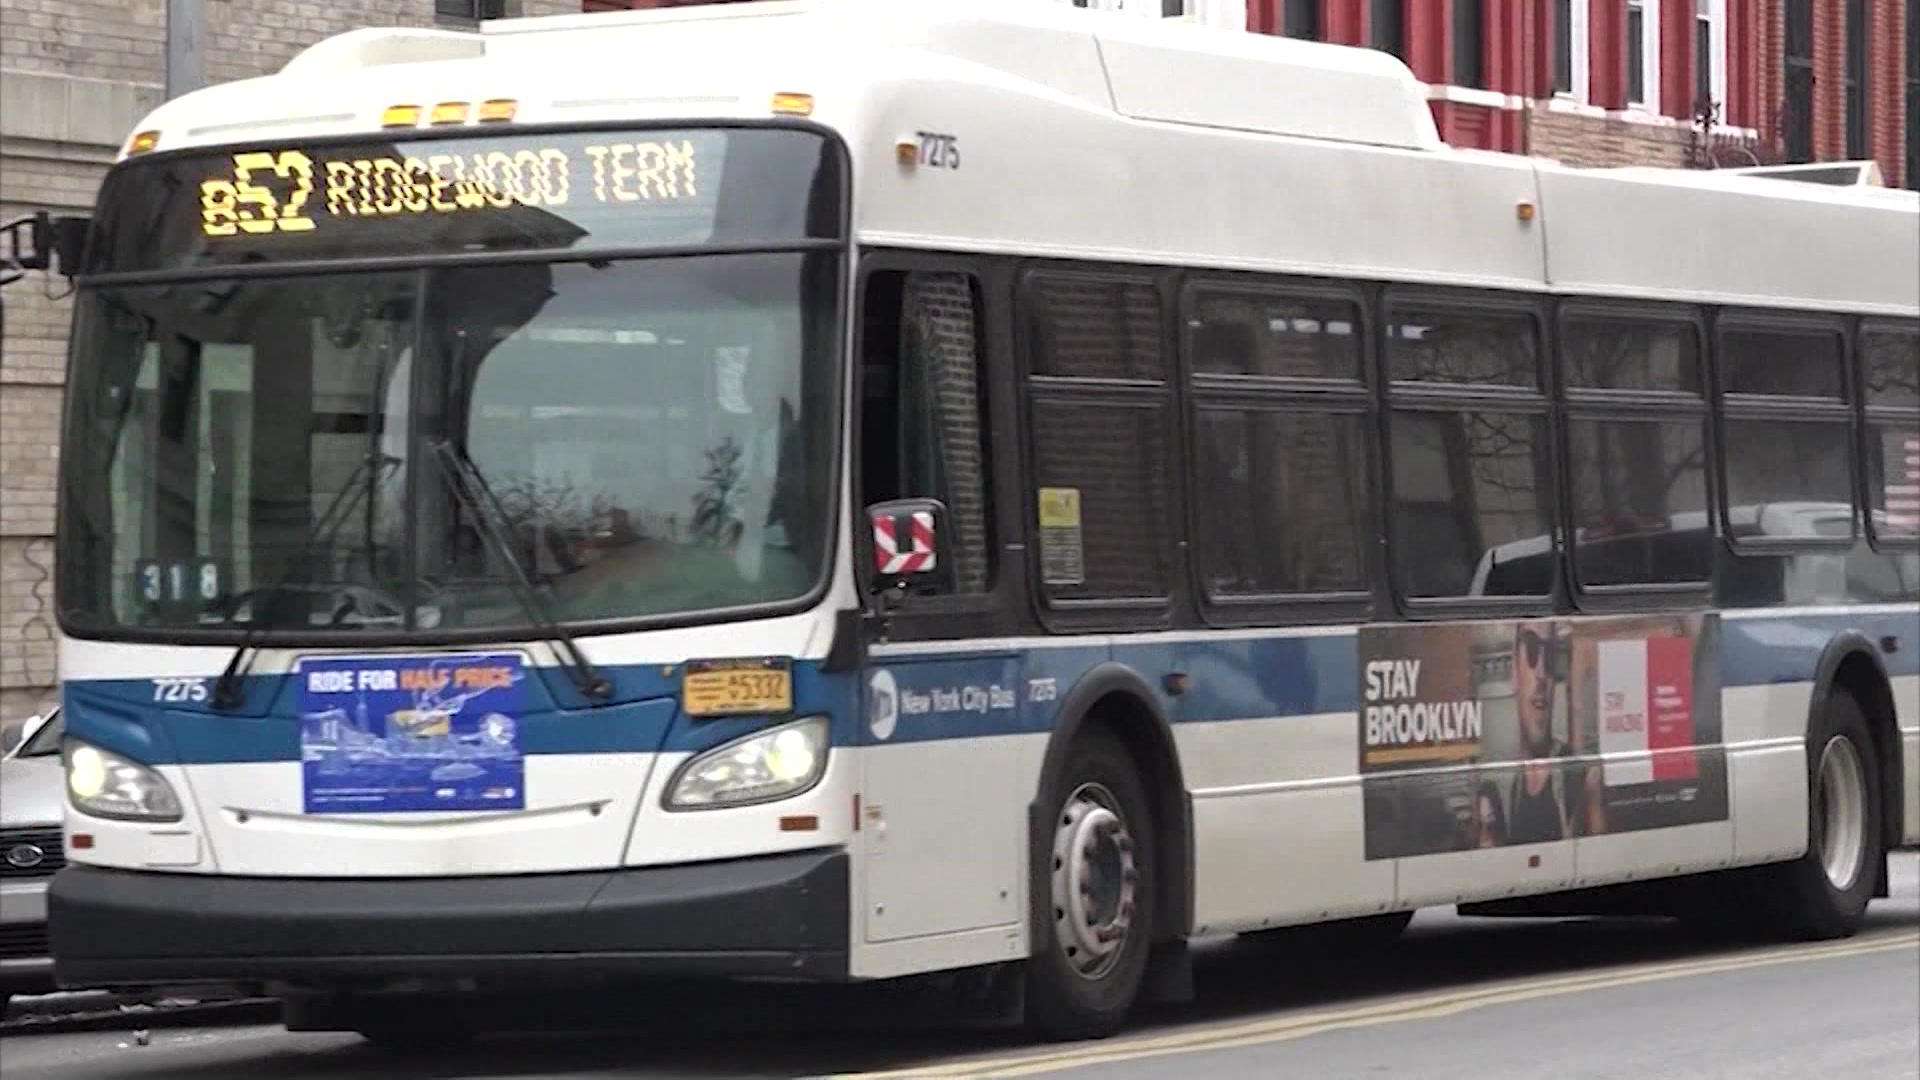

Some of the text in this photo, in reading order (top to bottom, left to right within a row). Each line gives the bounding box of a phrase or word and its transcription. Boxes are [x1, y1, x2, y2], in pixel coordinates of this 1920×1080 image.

[916, 131, 960, 171] 7275
[200, 140, 697, 236] B52 RIDGEWOOD TERM
[152, 677, 208, 702] 7275
[308, 671, 354, 692] RIDE
[358, 669, 397, 690] FOR
[901, 690, 930, 714] New
[931, 688, 960, 711] York
[961, 685, 988, 714] City
[990, 685, 1016, 709] Bus
[1365, 660, 1421, 701] STAY
[1365, 701, 1483, 745] BROOKLYN
